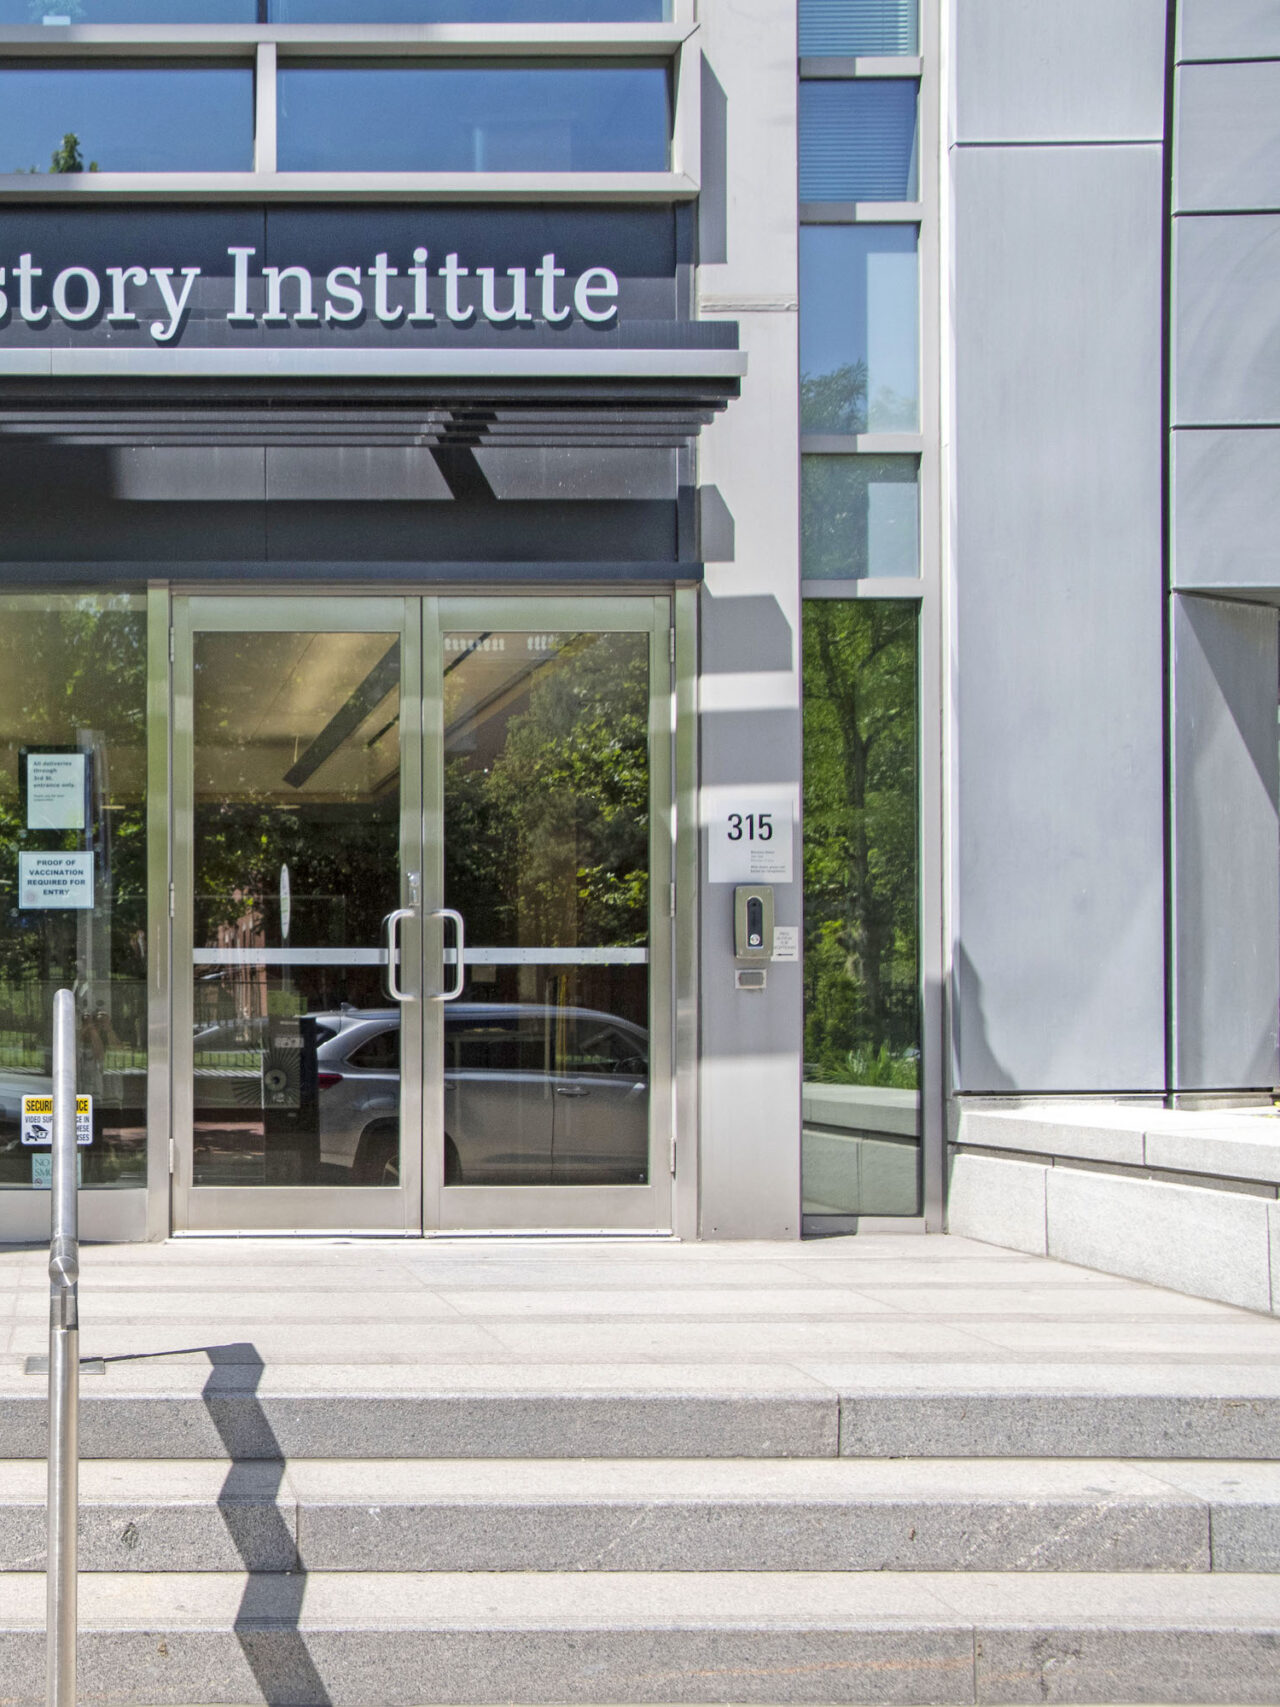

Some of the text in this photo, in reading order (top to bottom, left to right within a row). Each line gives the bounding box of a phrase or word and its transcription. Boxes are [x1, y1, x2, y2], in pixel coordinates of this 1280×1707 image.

[226, 246, 619, 323] Institute
[727, 813, 773, 841] 315
[26, 1100, 53, 1112] SECURI
